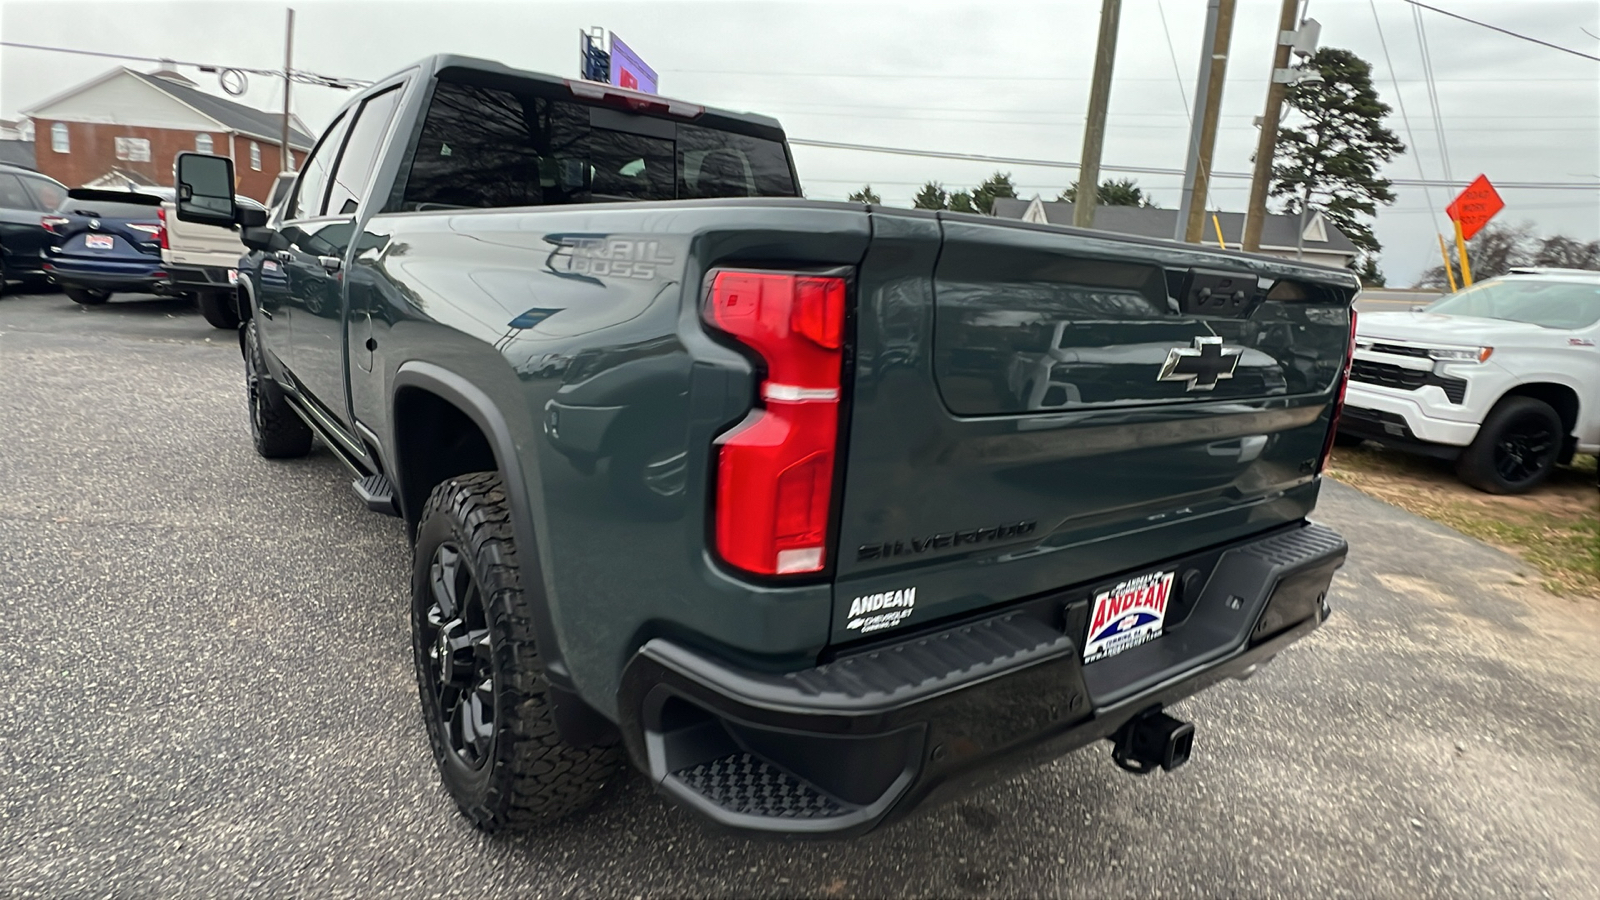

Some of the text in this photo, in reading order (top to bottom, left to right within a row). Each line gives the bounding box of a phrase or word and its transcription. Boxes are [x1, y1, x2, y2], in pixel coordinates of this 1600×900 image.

[561, 237, 675, 266] TRAIL
[571, 259, 657, 281] BOSS
[857, 521, 1037, 561] SILVERADO
[847, 587, 916, 619] ANDEAN
[1089, 578, 1170, 639] ANDEAN
